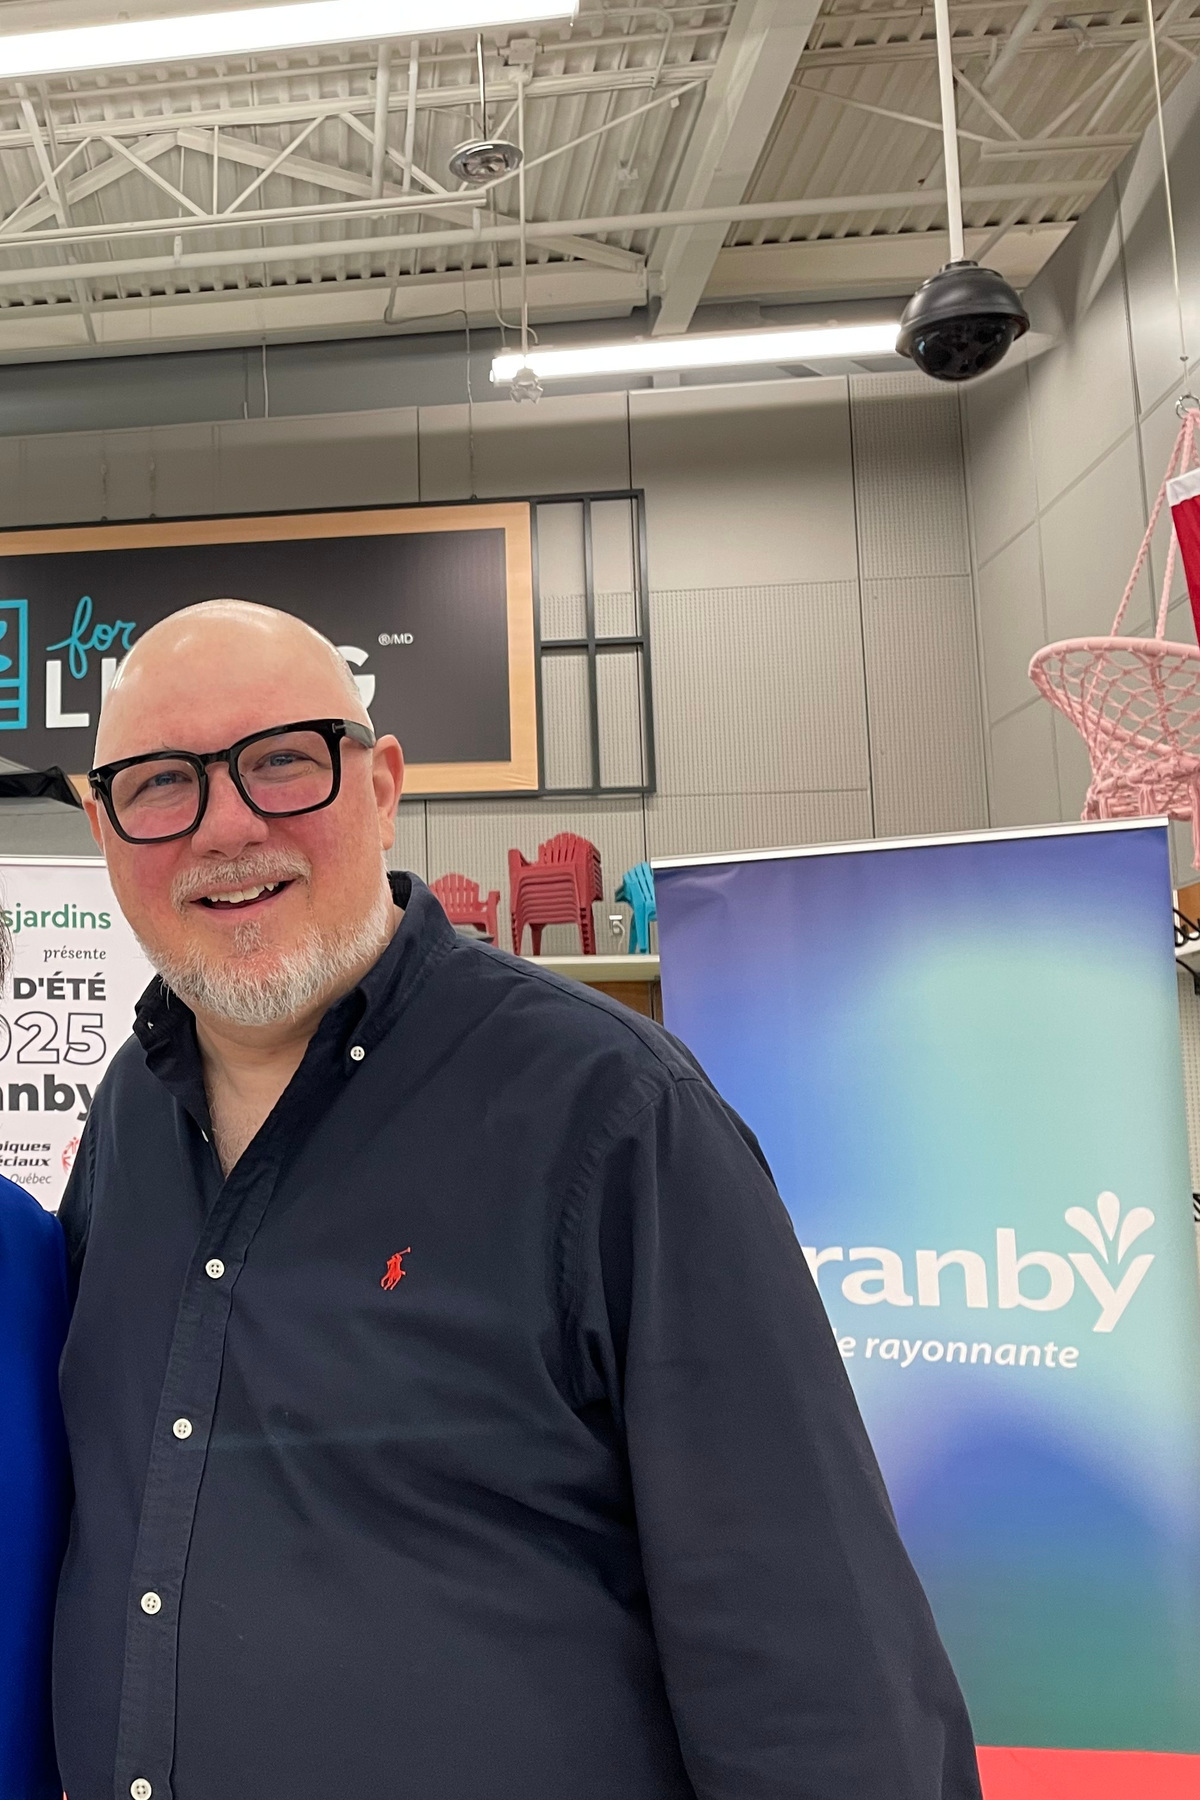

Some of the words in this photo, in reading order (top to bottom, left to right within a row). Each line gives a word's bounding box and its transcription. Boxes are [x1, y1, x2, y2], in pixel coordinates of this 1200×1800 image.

[46, 596, 136, 679] for
[2, 903, 111, 933] sjardins
[43, 945, 106, 962] présente
[13, 971, 106, 1001] D'ÉTÉ
[801, 1228, 1155, 1332] ranby
[865, 1337, 1080, 1368] rayonnante
